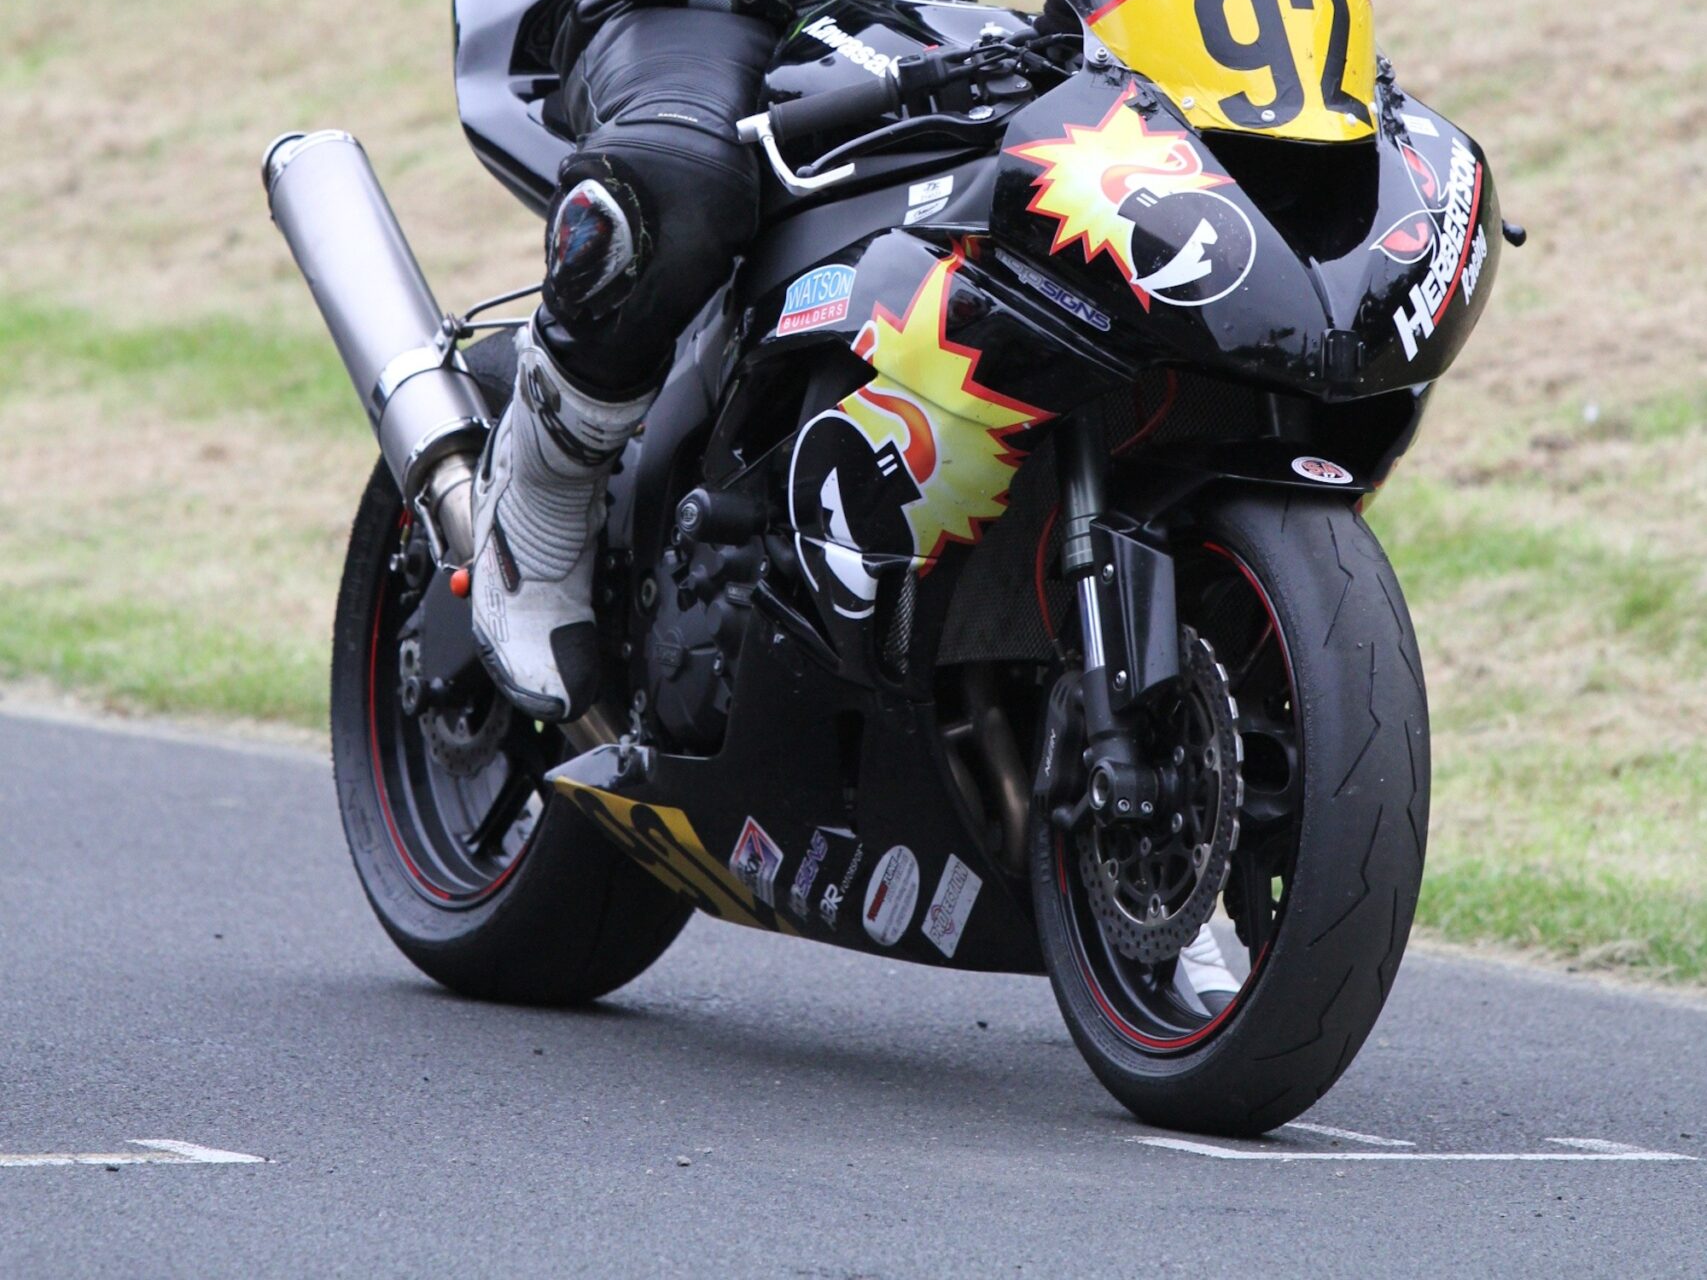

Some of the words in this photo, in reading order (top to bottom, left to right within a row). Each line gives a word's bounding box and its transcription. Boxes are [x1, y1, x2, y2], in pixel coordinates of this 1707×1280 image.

[1393, 137, 1477, 362] HERBERTSON
[788, 271, 852, 310] WATSON
[783, 303, 843, 330] BUILDERS
